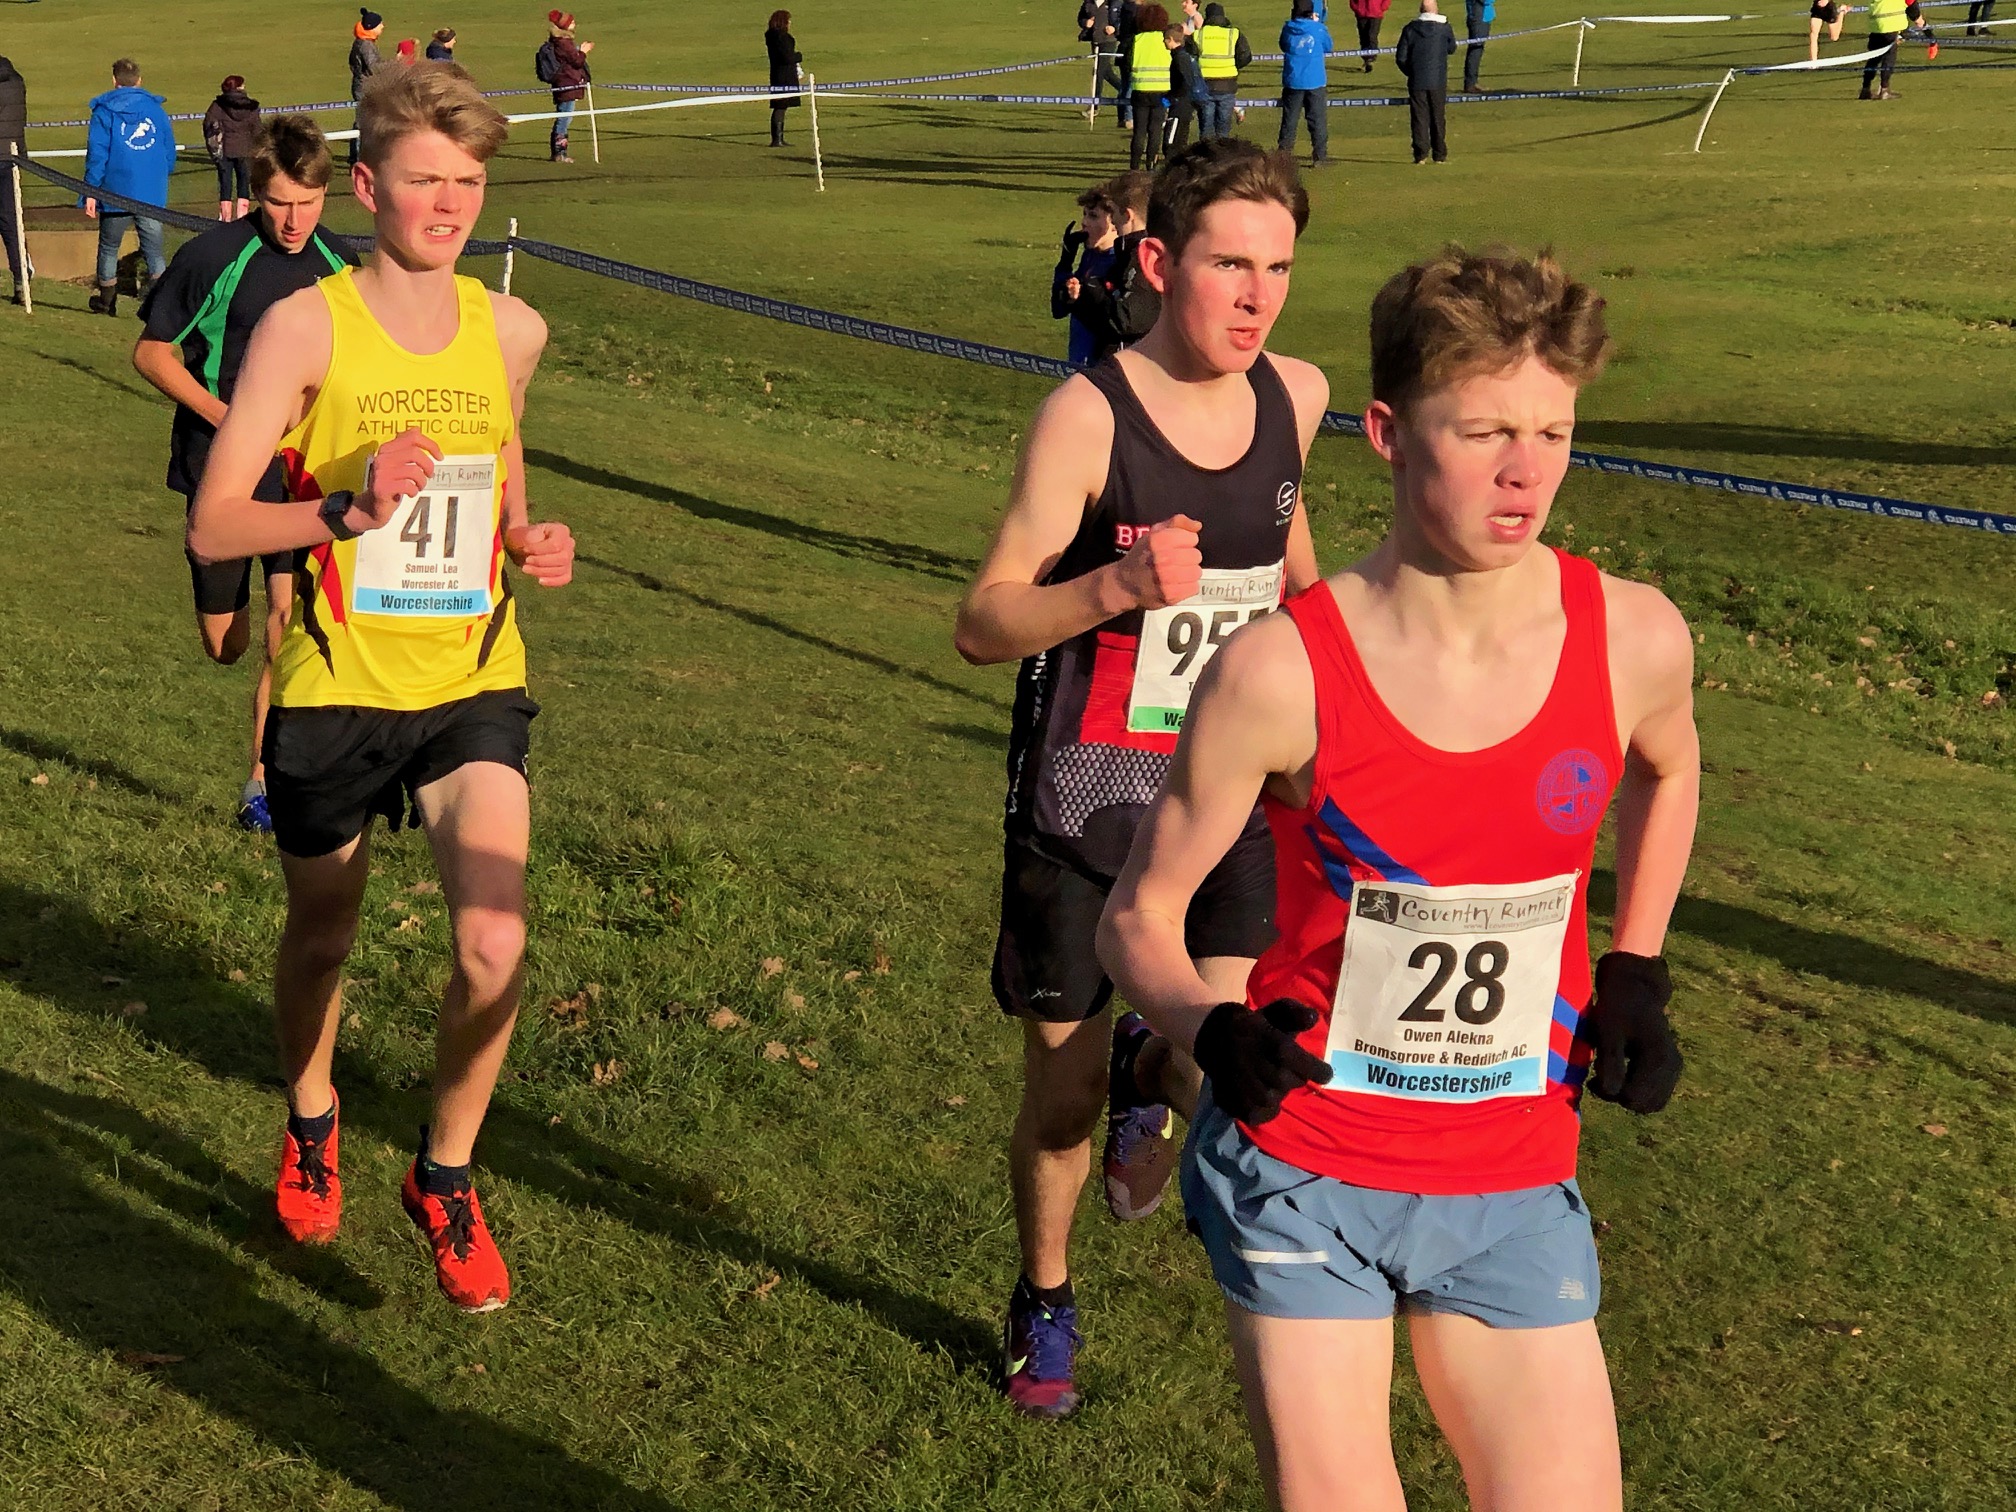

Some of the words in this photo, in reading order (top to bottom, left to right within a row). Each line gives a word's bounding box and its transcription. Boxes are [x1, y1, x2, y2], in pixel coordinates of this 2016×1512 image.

[357, 388, 491, 415] WORCESTER
[357, 419, 443, 435] ATHLETIC
[448, 420, 489, 435] CLUB
[400, 496, 459, 558] 41
[405, 563, 438, 574] Samuel
[443, 564, 458, 574] Lea
[401, 579, 446, 590] Worcester
[447, 580, 459, 590] AC
[380, 594, 473, 610] Worcestershire
[1167, 607, 1270, 676] 95
[1401, 899, 1495, 930] Coventry
[1501, 896, 1563, 920] Runner
[1397, 940, 1510, 1025] 28
[1403, 1028, 1442, 1043] Owen
[1446, 1029, 1494, 1045] Alekna
[1354, 1038, 1435, 1064] Bromsgrove
[1439, 1052, 1450, 1064] &
[1454, 1050, 1508, 1066] Redditch
[1511, 1044, 1527, 1057] AC
[1367, 1063, 1512, 1094] Worcestershire
